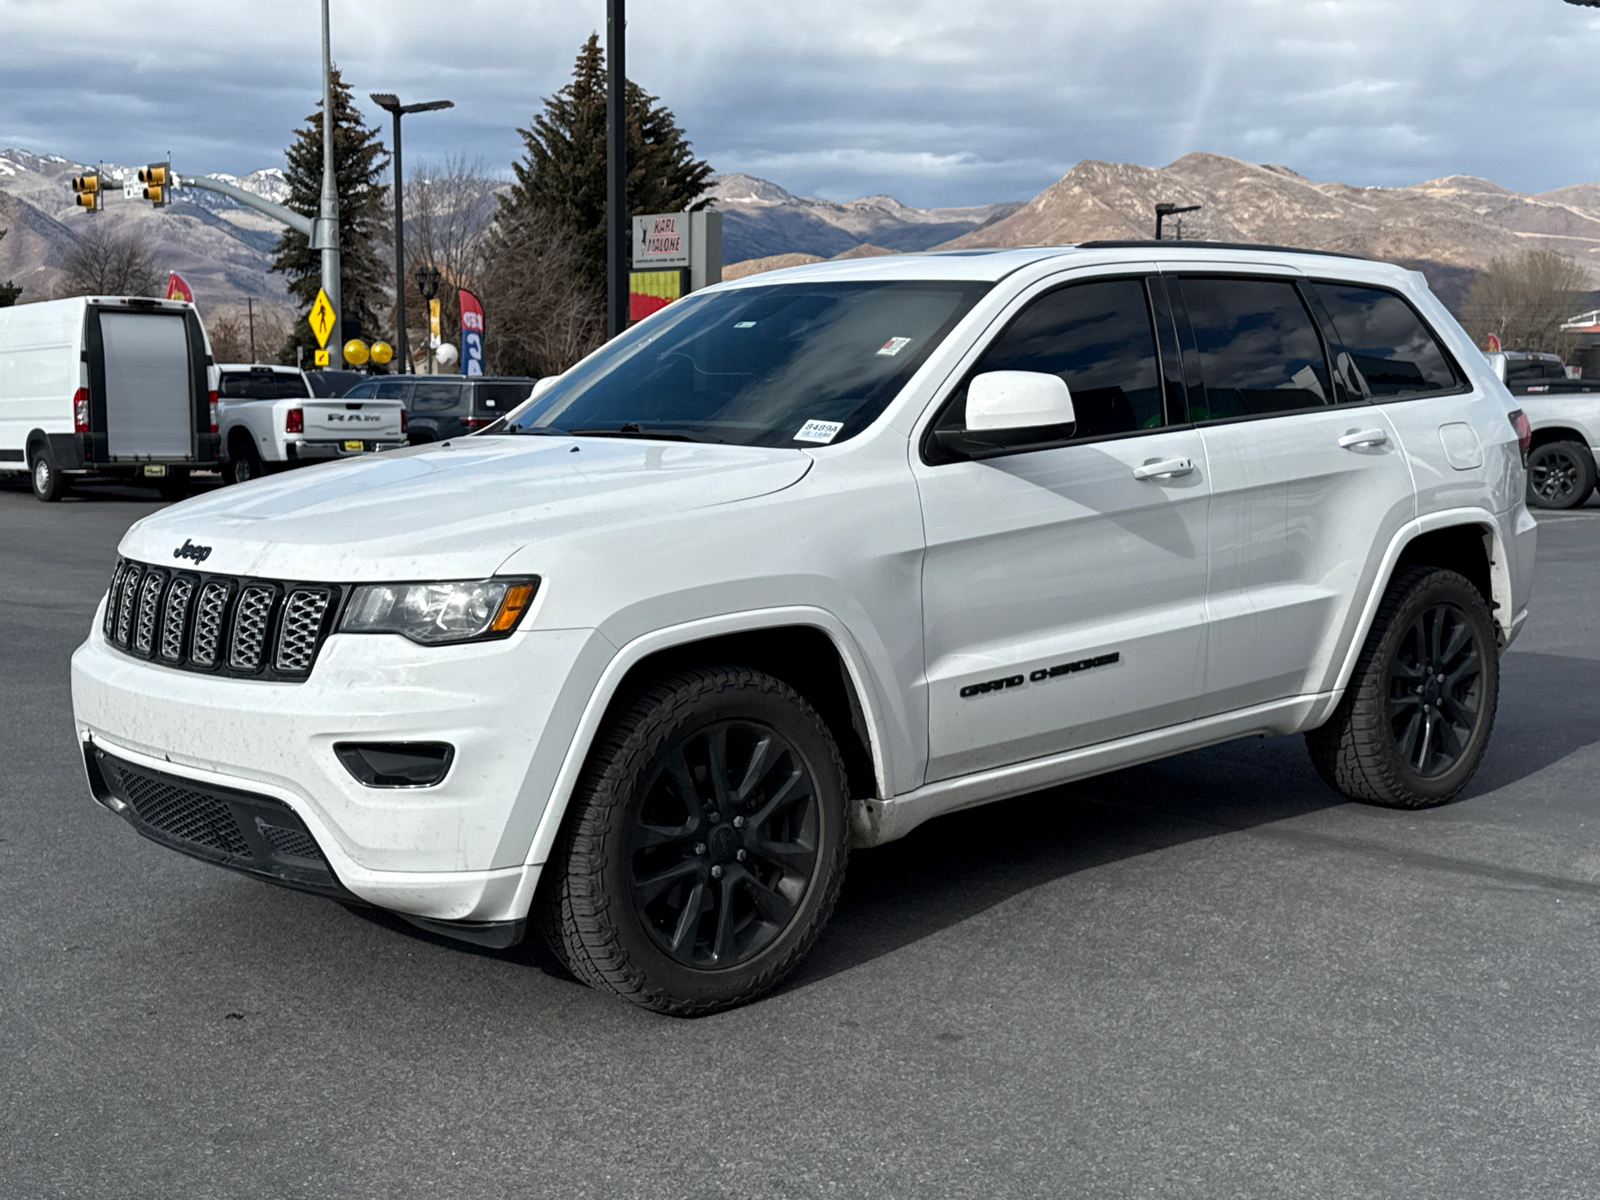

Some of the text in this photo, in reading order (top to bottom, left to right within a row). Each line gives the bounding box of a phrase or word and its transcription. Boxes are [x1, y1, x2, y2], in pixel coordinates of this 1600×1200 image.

[653, 217, 676, 235] KARL
[647, 236, 682, 254] MALONE
[805, 423, 838, 433] 8489A
[173, 538, 212, 566] Jeep
[960, 651, 1120, 698] GRAND CHEROKEE
